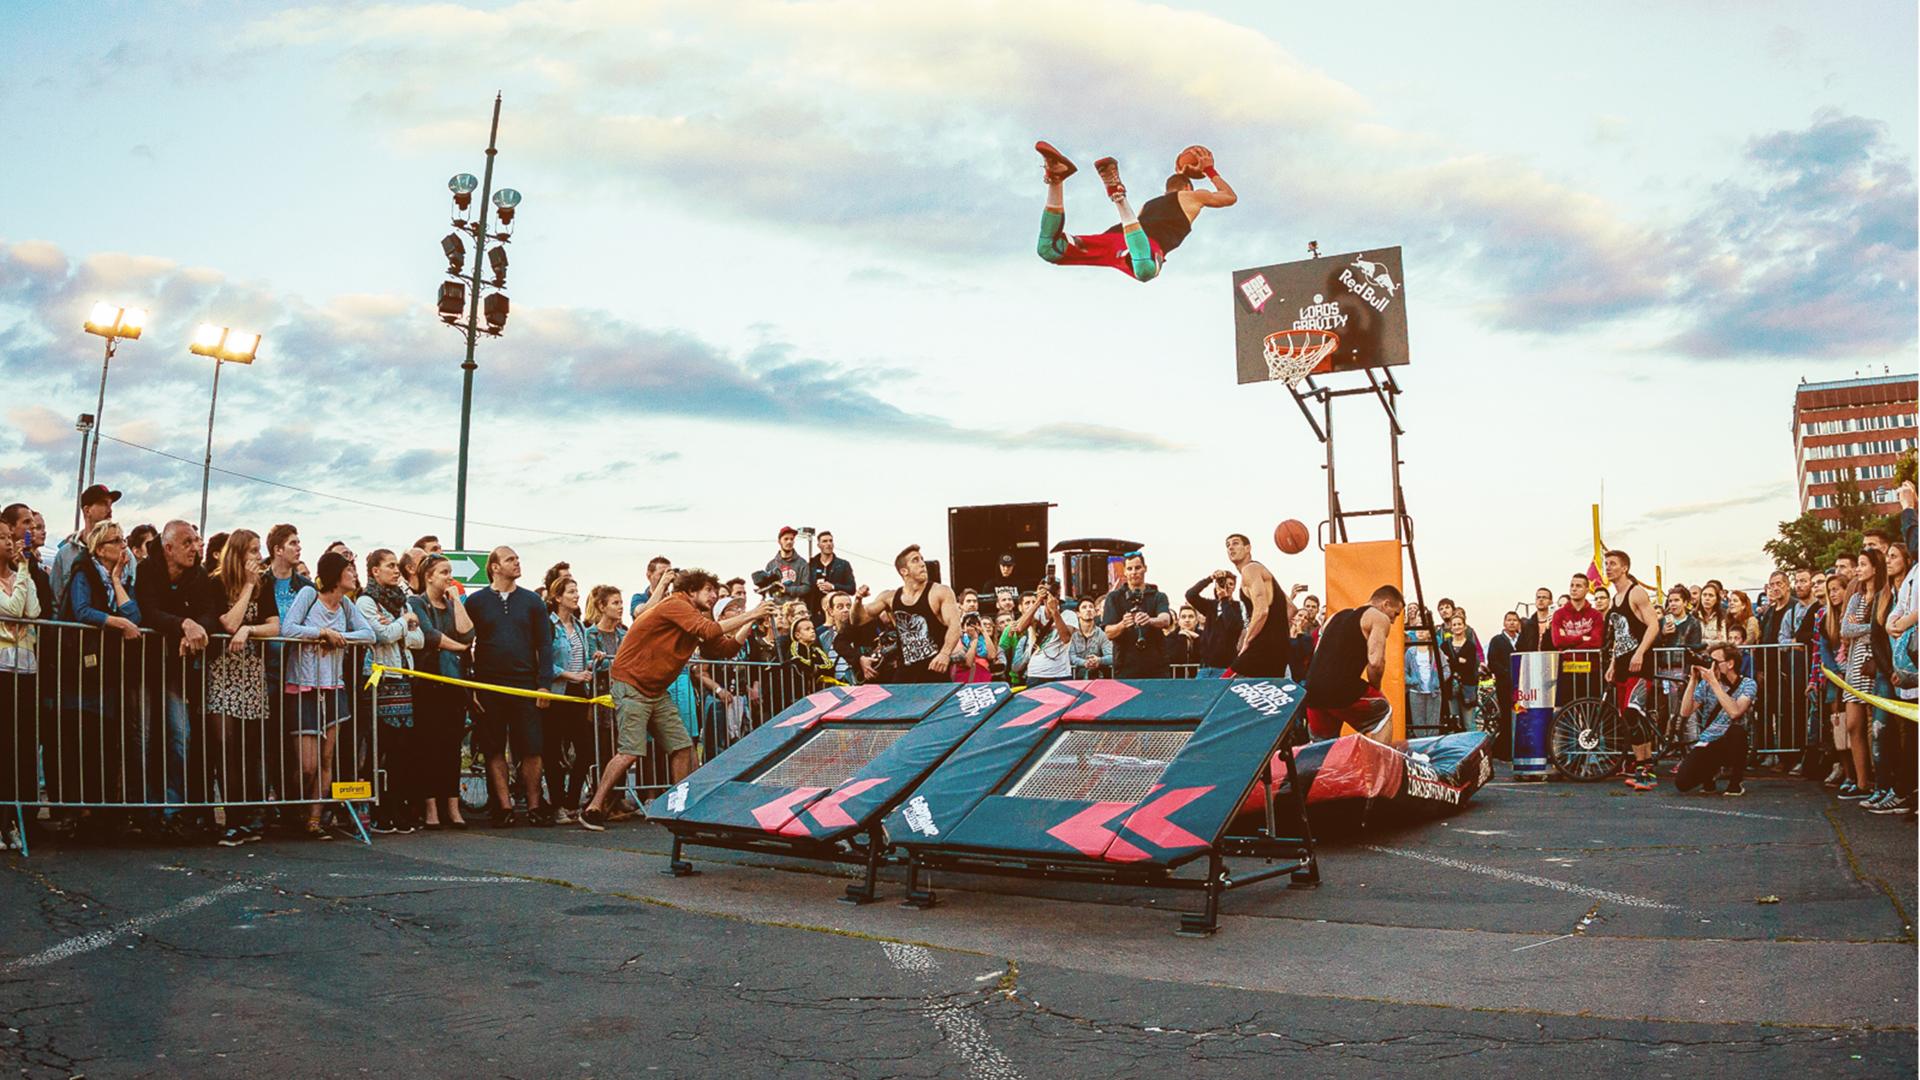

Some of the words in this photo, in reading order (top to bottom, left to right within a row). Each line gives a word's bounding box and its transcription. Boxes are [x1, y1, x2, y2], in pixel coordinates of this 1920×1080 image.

[1339, 268, 1368, 295] Red
[1361, 286, 1390, 312] Bull
[1299, 302, 1340, 320] LORDS
[1253, 681, 1294, 707] LORDS
[1517, 688, 1537, 701] Bull
